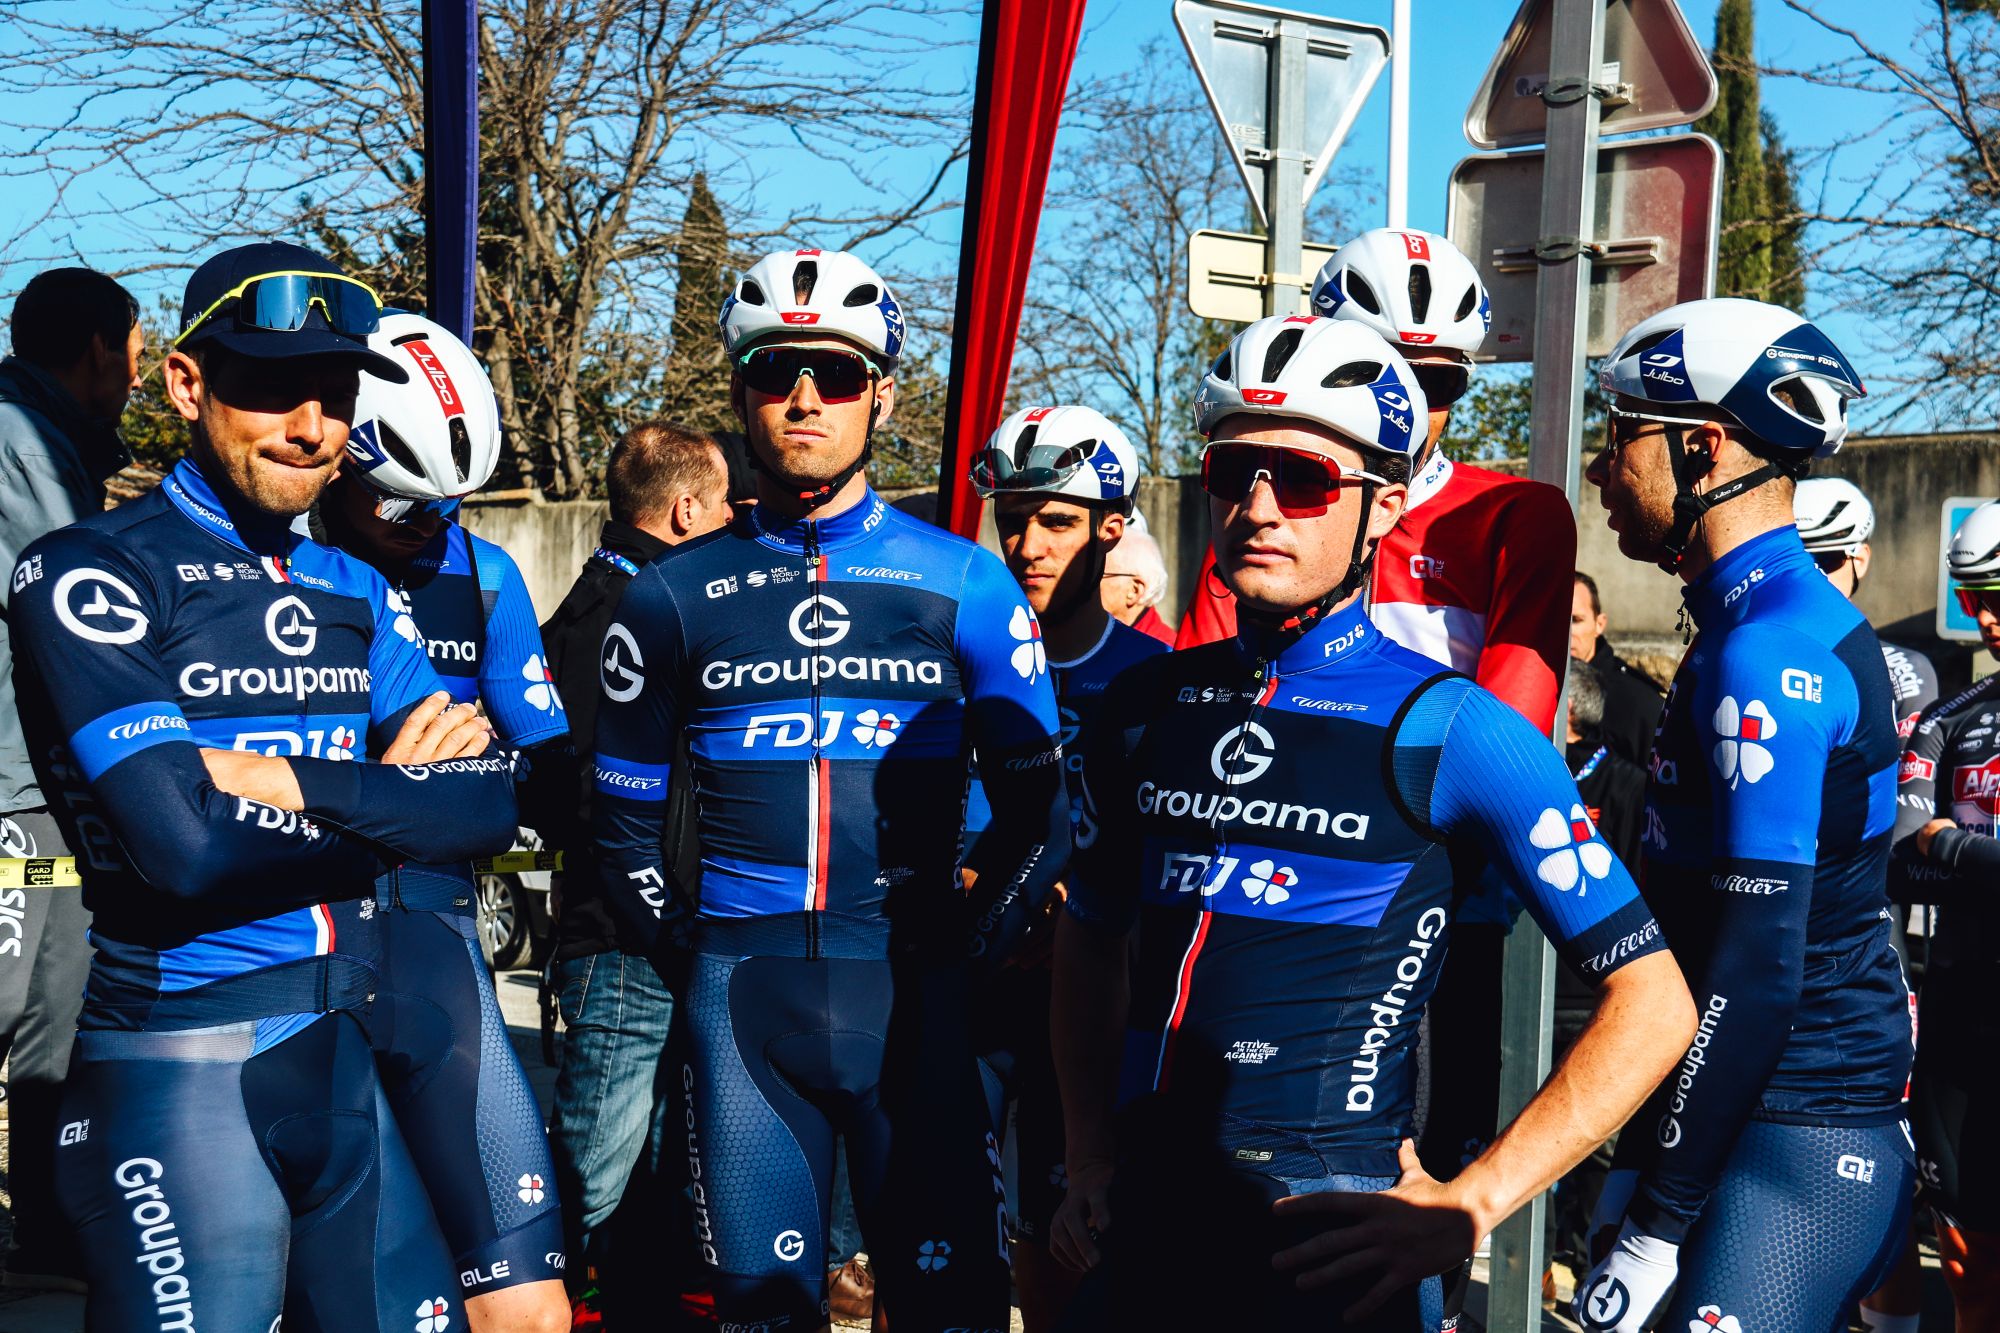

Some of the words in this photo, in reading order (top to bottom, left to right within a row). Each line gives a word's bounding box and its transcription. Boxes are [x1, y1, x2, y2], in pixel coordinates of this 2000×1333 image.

[1778, 351, 1815, 361] Groupama
[411, 347, 454, 405] Julbo
[1642, 368, 1685, 386] Julbo
[1383, 412, 1410, 434] Julbo
[863, 508, 883, 533] FDJ
[237, 567, 263, 575] WORLD
[772, 570, 800, 579] WORLD
[847, 566, 922, 581] Wilier
[1723, 578, 1749, 609] FDJ
[1324, 632, 1355, 658] FDJ
[702, 654, 942, 690] Groupama
[1292, 696, 1369, 711] Wilier
[742, 710, 844, 748] FDJ
[592, 763, 661, 790] Wilier
[236, 796, 298, 835] FDJ
[1138, 781, 1370, 840] Groupama
[27, 867, 51, 875] GARD
[1160, 852, 1240, 897] FDJ
[977, 844, 1045, 932] Groupama
[1712, 875, 1788, 895] Wilier
[1755, 877, 1789, 885] TRIESTINA
[1581, 922, 1660, 972] Wilier
[1346, 907, 1446, 1112] Groupama
[1223, 1051, 1277, 1062] AGAINST
[1232, 1039, 1271, 1049] ACTIVE
[1671, 994, 1729, 1114] Groupama
[683, 1063, 719, 1266] Groupama
[115, 1157, 197, 1333] Groupam
